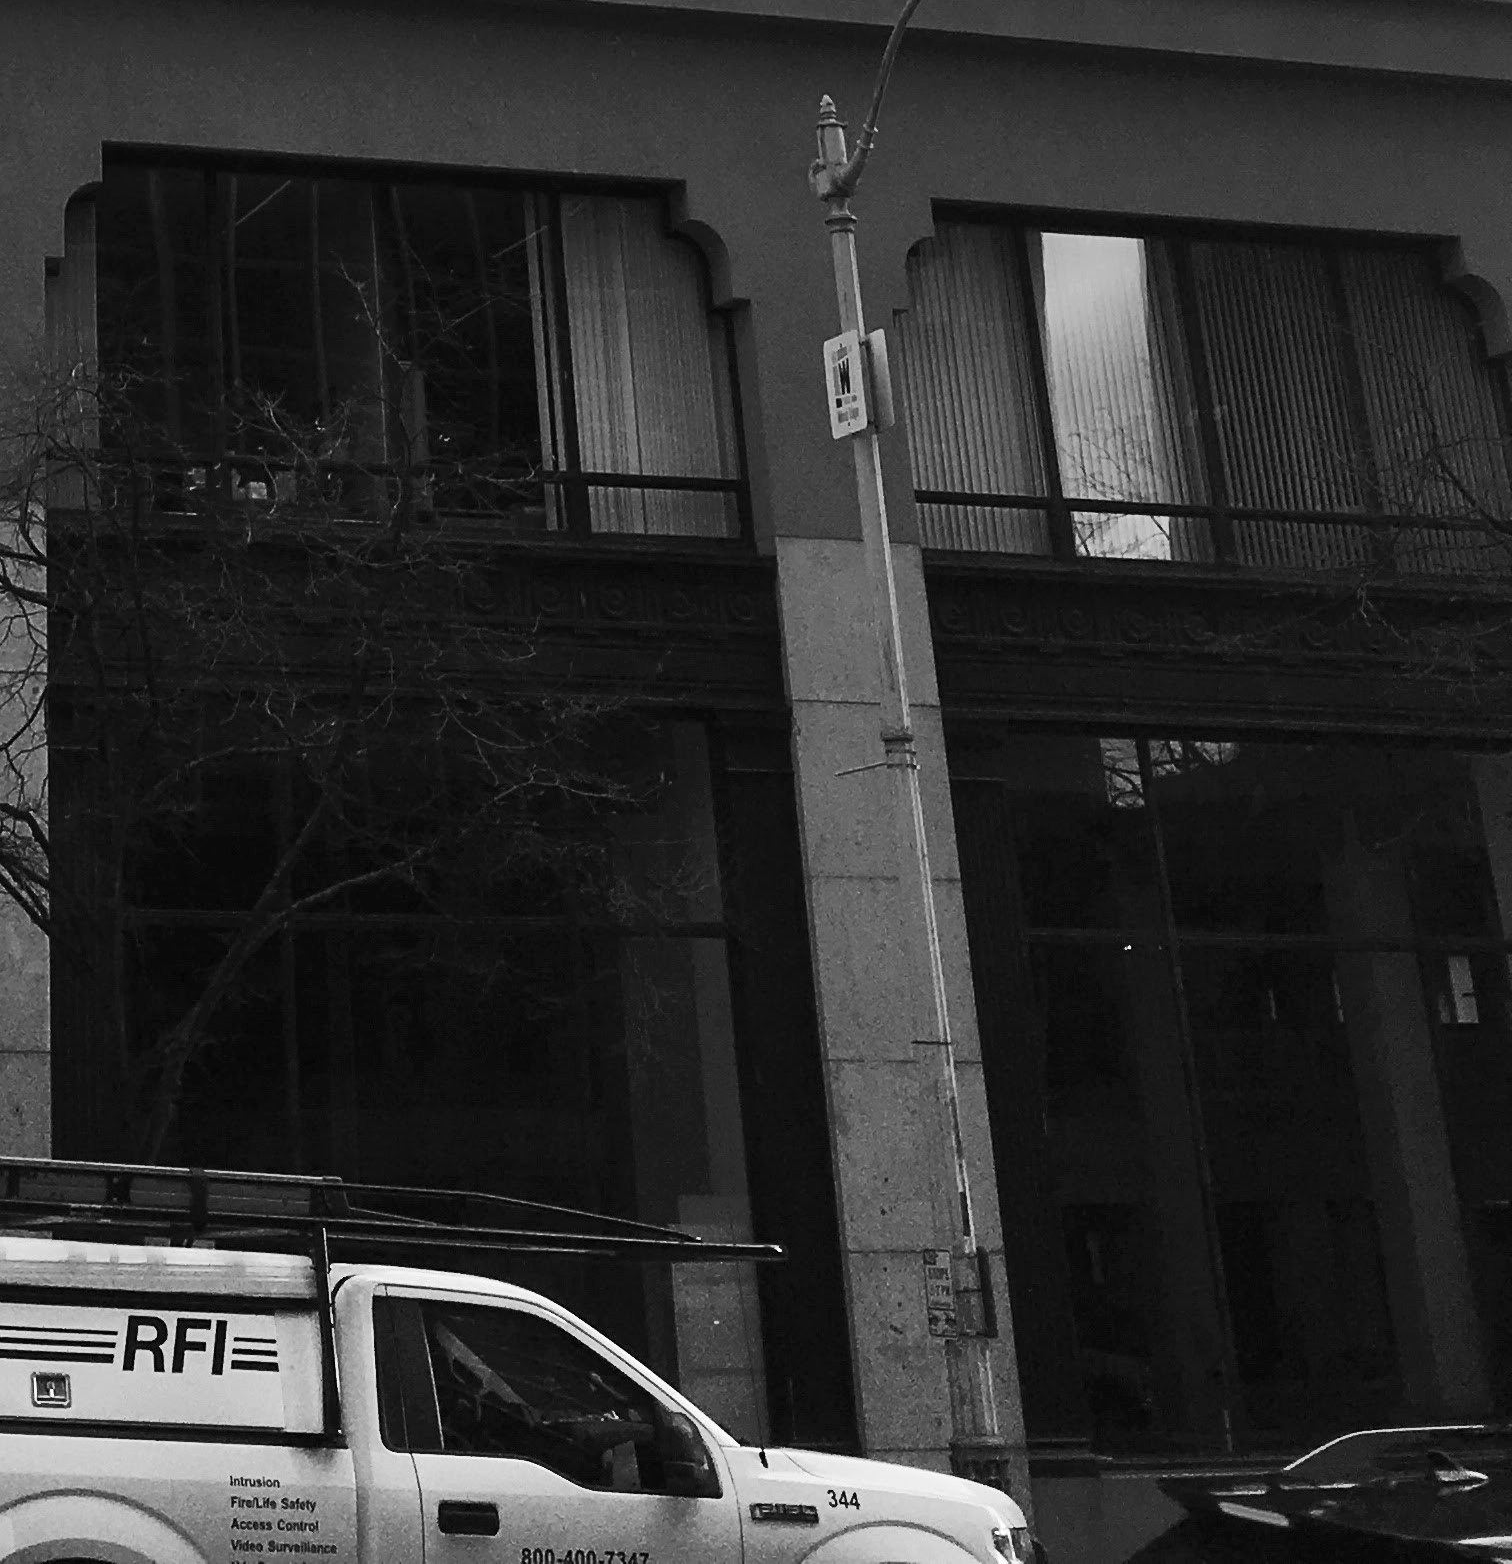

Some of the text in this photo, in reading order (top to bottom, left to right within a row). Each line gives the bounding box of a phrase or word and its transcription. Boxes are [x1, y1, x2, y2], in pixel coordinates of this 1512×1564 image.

[123, 1315, 228, 1376] RFI
[229, 1476, 280, 1488] Intrusion
[230, 1496, 316, 1512] Fire/Life Safety
[827, 1489, 861, 1510] 344
[231, 1518, 319, 1532] Access Control
[231, 1539, 337, 1554] Video Surveillance
[520, 1547, 650, 1564] 800-400-7347
